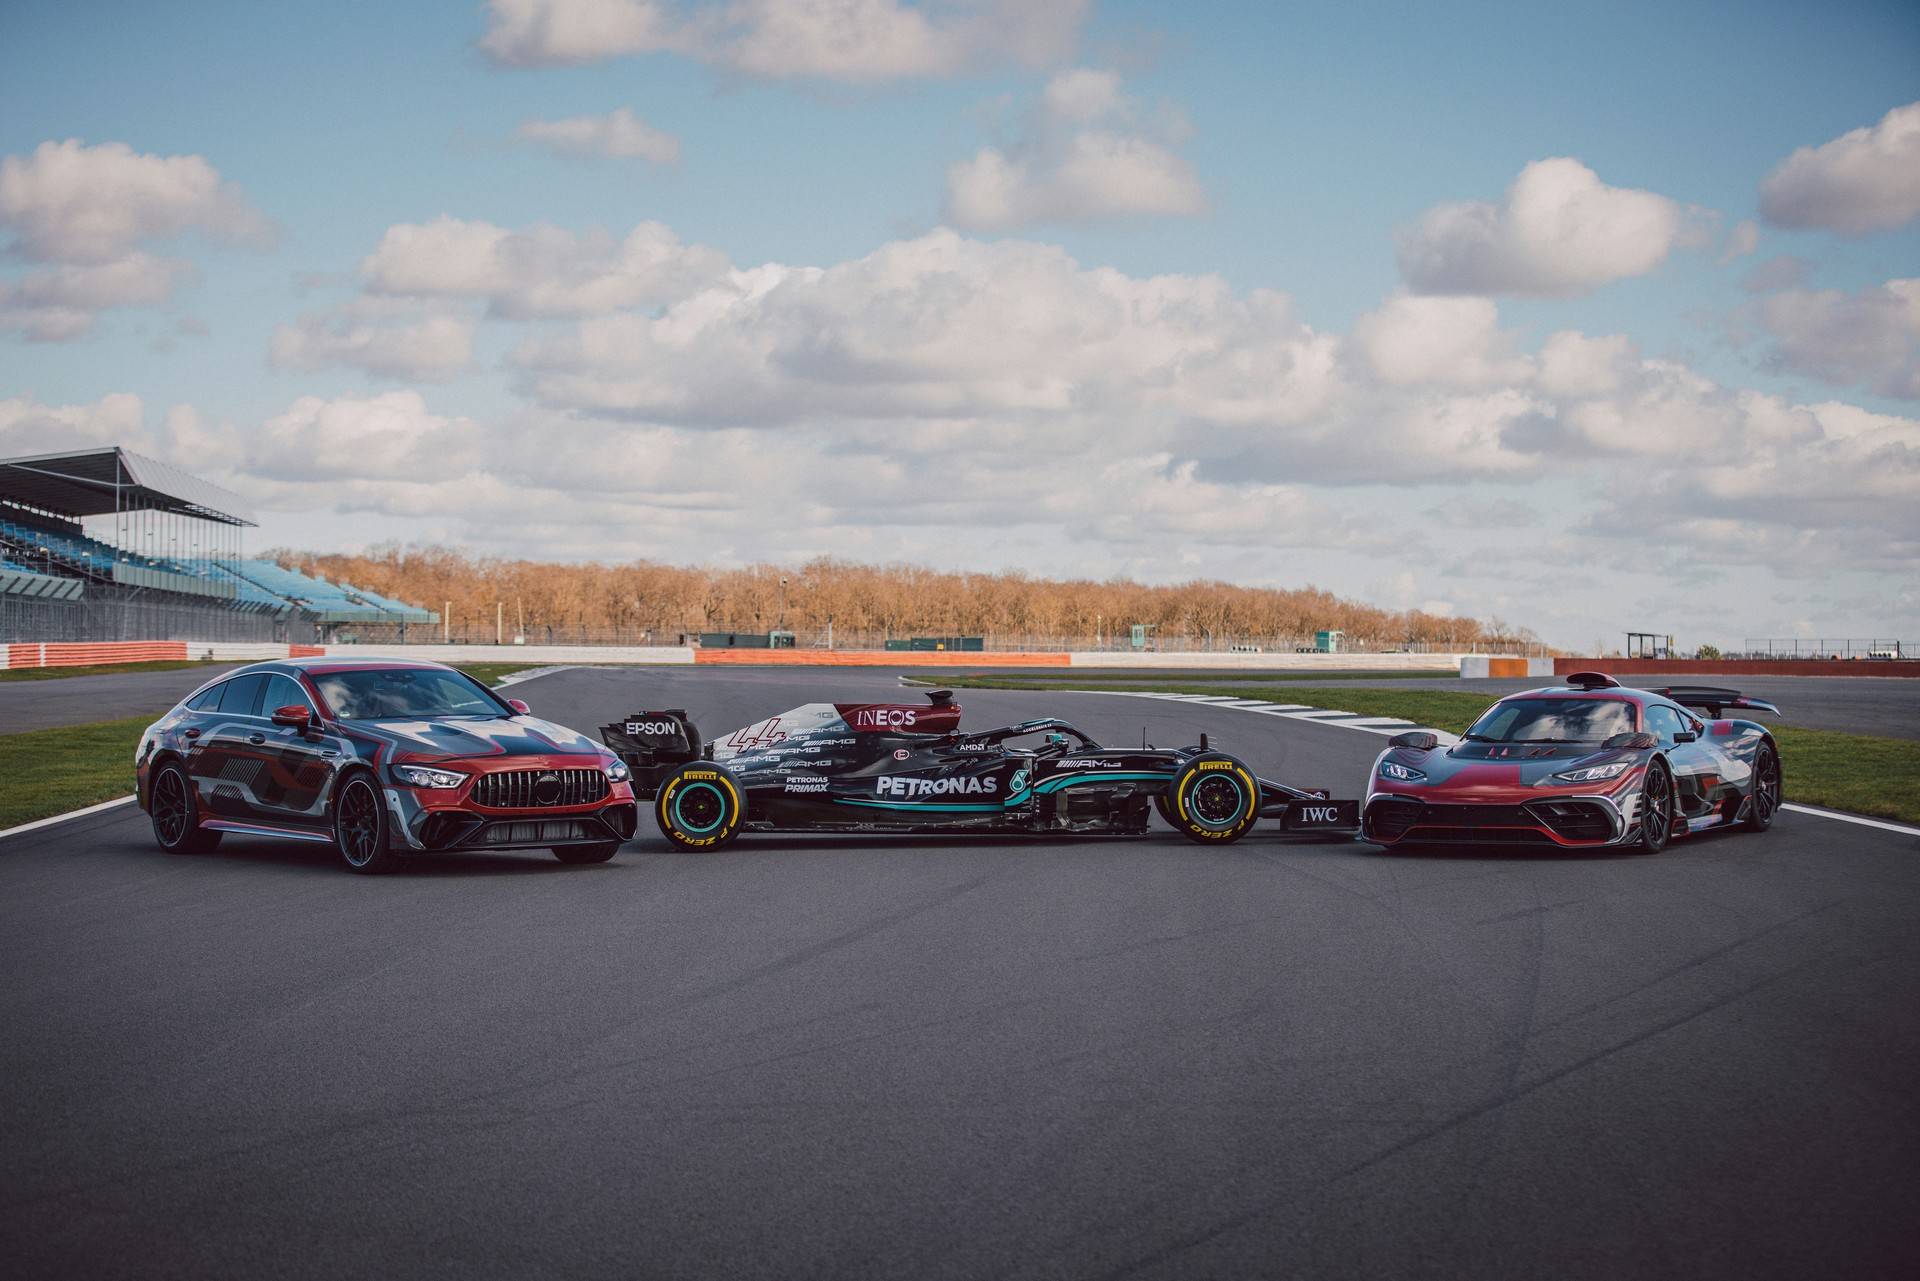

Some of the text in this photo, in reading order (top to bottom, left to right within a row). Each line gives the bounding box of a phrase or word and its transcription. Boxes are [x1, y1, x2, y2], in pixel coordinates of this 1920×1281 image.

[857, 709, 916, 726] INEOS
[626, 722, 676, 735] EPSON
[727, 717, 787, 754] 44
[820, 738, 856, 746] AMG
[959, 743, 978, 751] AMD
[796, 760, 832, 768] AMG
[784, 782, 830, 793] PRIMAX
[876, 776, 998, 796] PETRONAS
[1301, 807, 1338, 822] IWC
[673, 831, 717, 846] ZERO
